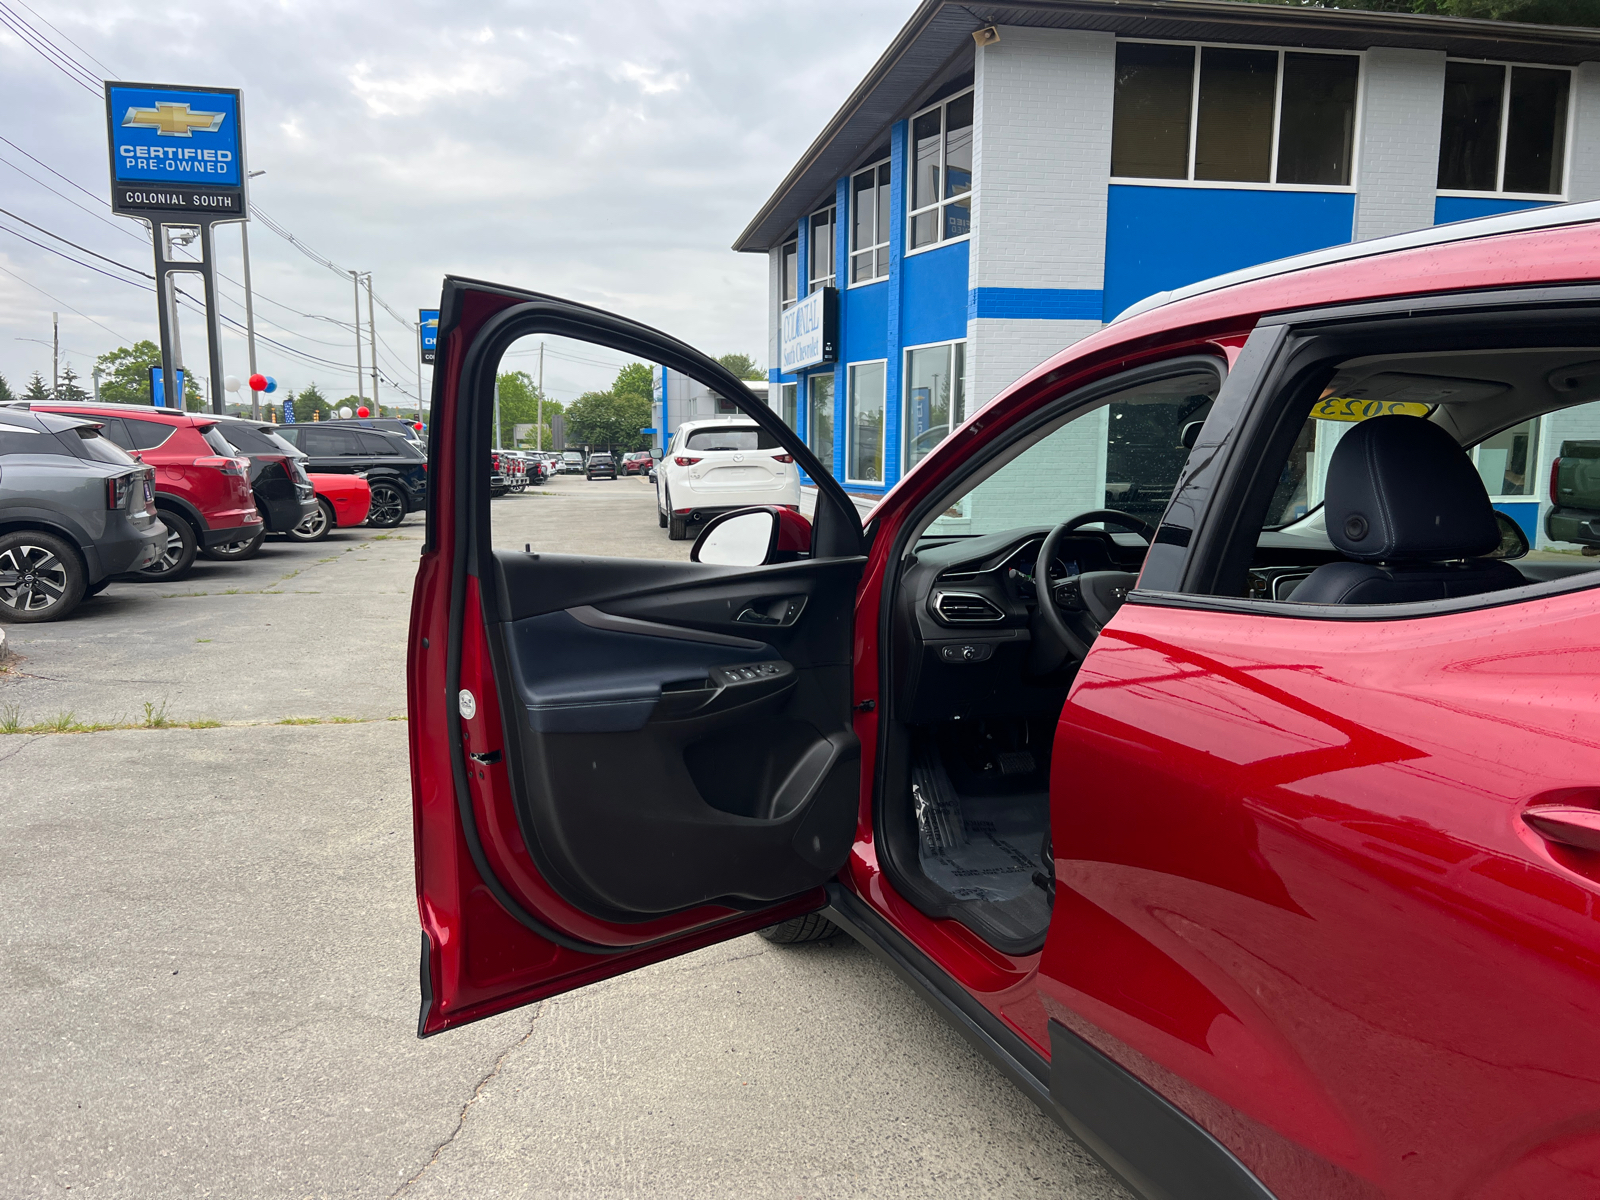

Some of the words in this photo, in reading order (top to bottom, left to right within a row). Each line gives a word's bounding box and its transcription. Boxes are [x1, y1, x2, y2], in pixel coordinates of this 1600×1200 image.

[119, 145, 232, 161] CERTIFIED
[126, 158, 227, 173] PRE-OWNED
[126, 191, 186, 205] COLONIAL
[193, 195, 232, 207] SOUTH
[783, 299, 819, 343] COLONIAL
